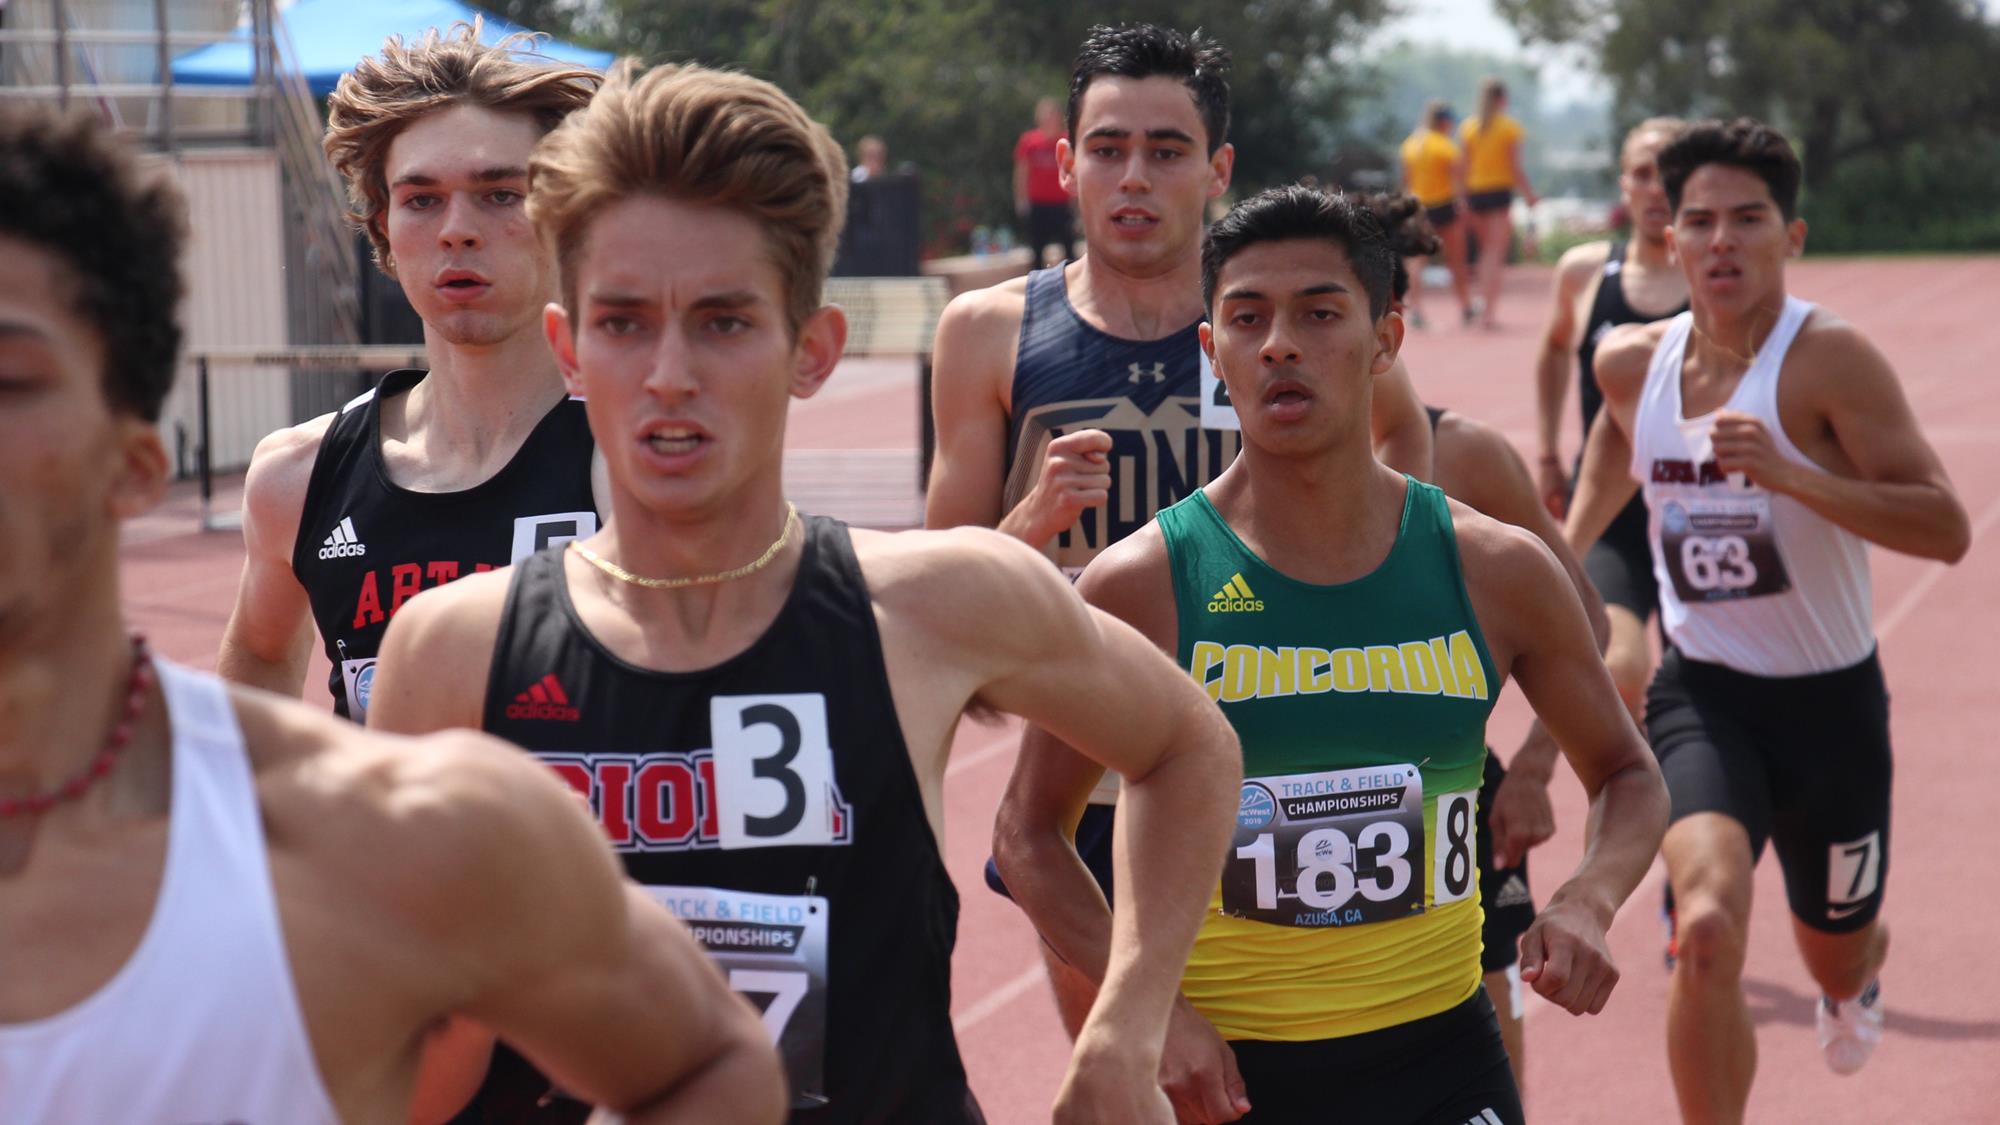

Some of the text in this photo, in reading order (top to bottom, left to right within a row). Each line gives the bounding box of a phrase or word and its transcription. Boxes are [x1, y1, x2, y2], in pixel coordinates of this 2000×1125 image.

[318, 540, 366, 560] adidas
[1681, 535, 1757, 590] 63
[1208, 597, 1265, 613] adidas
[1191, 630, 1489, 703] CONCORDIA
[507, 703, 580, 721] adidas
[739, 703, 807, 838] 3
[1282, 772, 1404, 797] TRACK & FIELD
[1288, 792, 1398, 816] CHAMPIONSHIPS
[1444, 797, 1471, 896] 8
[1236, 821, 1412, 912] 183
[1844, 841, 1871, 898] 7
[717, 899, 731, 918] &
[739, 902, 803, 924] FIELD
[1295, 909, 1363, 926] AZUSA, CA
